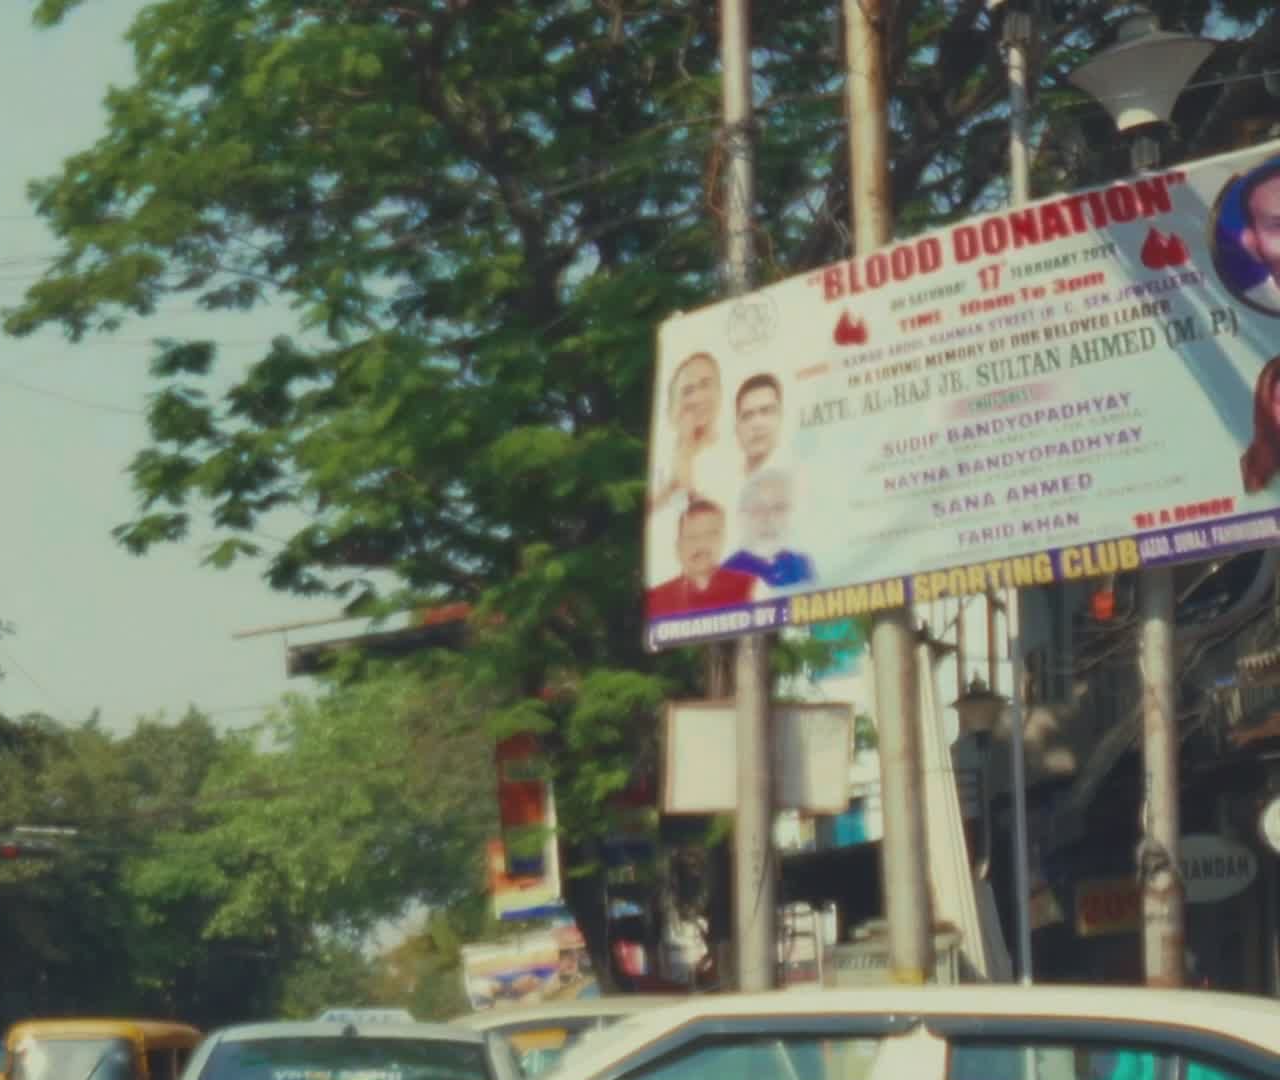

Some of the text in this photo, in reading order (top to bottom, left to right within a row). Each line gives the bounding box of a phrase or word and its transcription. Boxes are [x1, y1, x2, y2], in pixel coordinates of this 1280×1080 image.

[926, 342, 985, 367] MEMORY
[990, 337, 1005, 351] OF
[1011, 329, 1039, 348] OUR
[1043, 313, 1110, 341] BELOVED
[1114, 300, 1171, 326] LEADER
[976, 345, 1061, 387] SULTAN
[1070, 326, 1156, 369] AHMED
[883, 431, 939, 459] SUDIP
[947, 391, 1132, 444] BANDYOPADHYAY
[883, 467, 950, 492] NAYNA
[957, 426, 1143, 477] BANDYOPADHYAY
[932, 491, 996, 518] SANA
[1006, 473, 1093, 503] AHMED
[958, 522, 1014, 547] FARID
[1022, 511, 1081, 535] KHAN
[656, 610, 751, 641] ORGANISED
[754, 606, 776, 626] BY
[791, 578, 905, 626] RAHMAN
[912, 552, 1053, 602] SPORTING
[1060, 536, 1140, 580] CLUB
